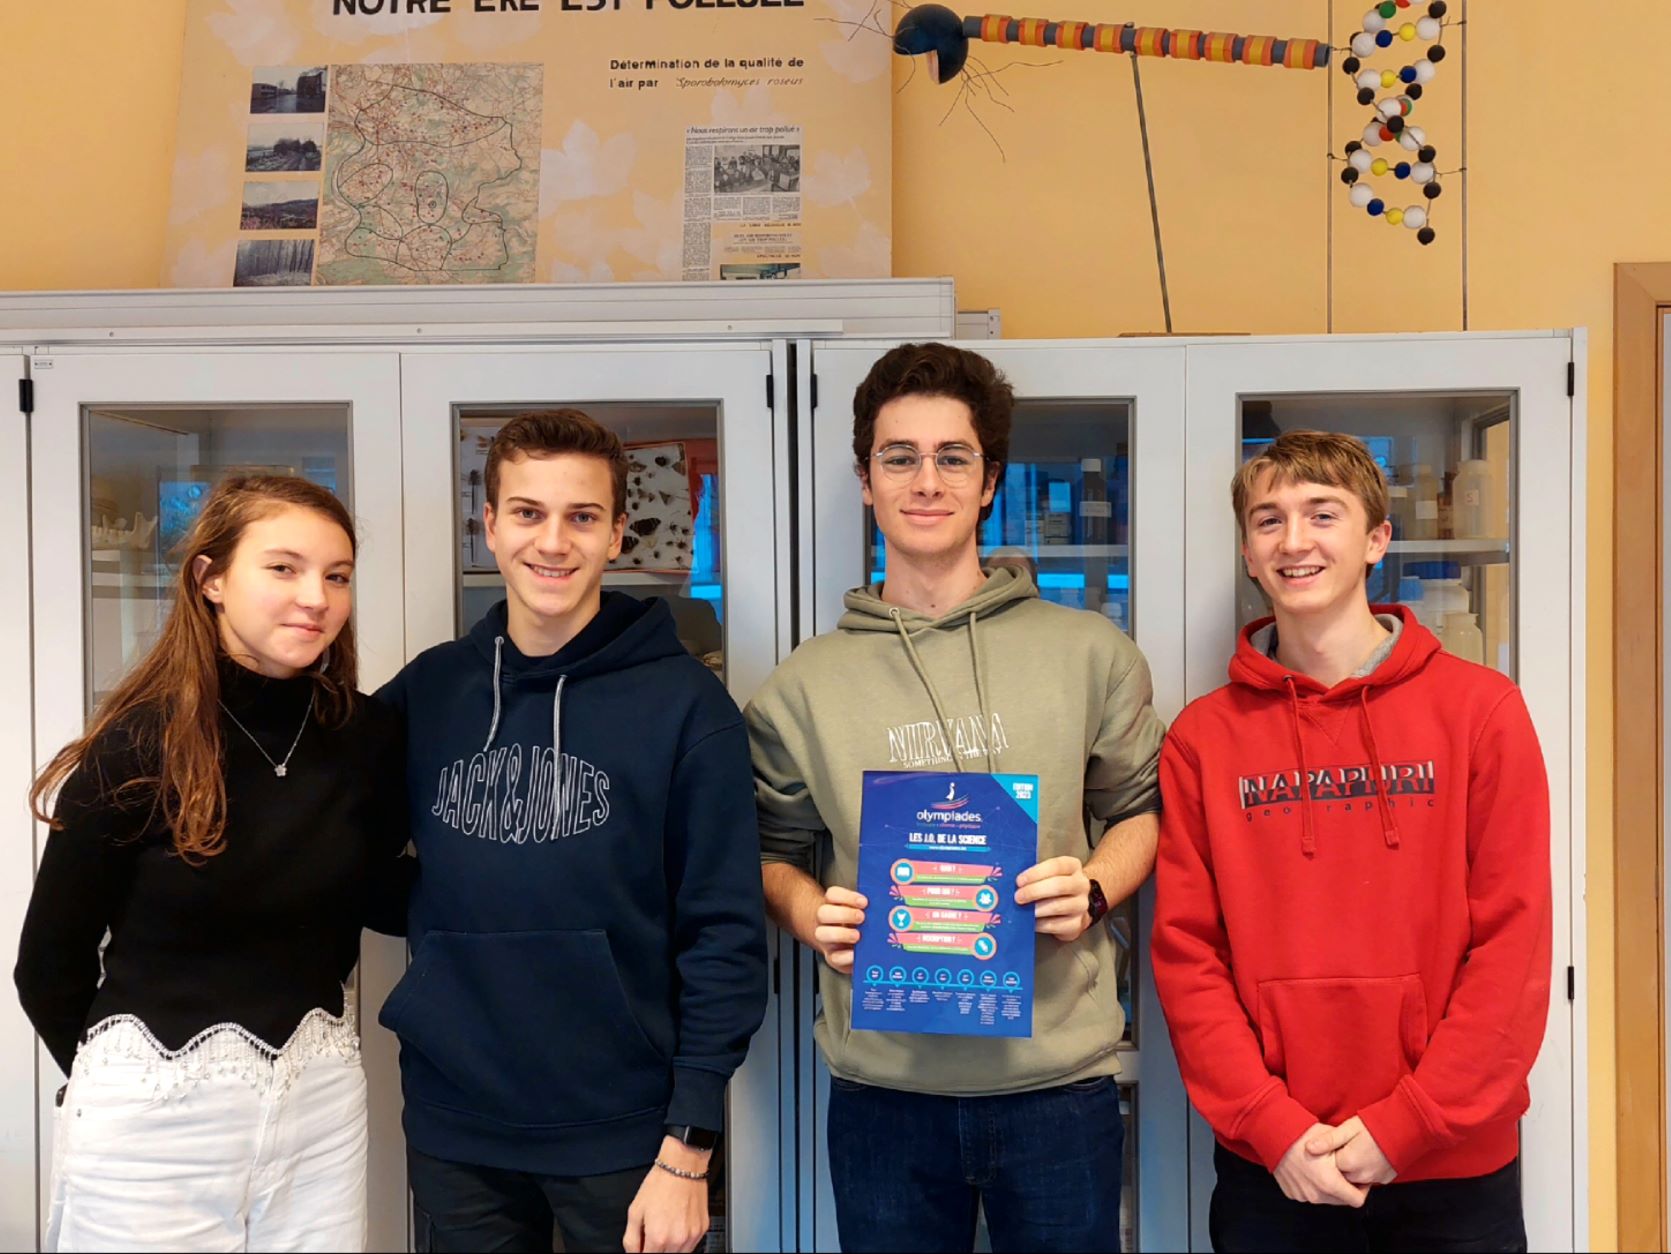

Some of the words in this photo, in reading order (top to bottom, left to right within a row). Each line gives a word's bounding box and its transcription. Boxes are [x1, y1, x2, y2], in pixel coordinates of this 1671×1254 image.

[610, 59, 700, 71] Détermination
[704, 58, 721, 69] de
[725, 57, 736, 68] la
[740, 57, 783, 70] qualité
[788, 56, 805, 68] de
[638, 79, 659, 91] par
[887, 713, 1009, 763] NIRVANA
[431, 743, 610, 845] JACK&JONES
[1246, 799, 1434, 823] georaphic
[909, 832, 923, 842] LES
[948, 834, 957, 844] LA
